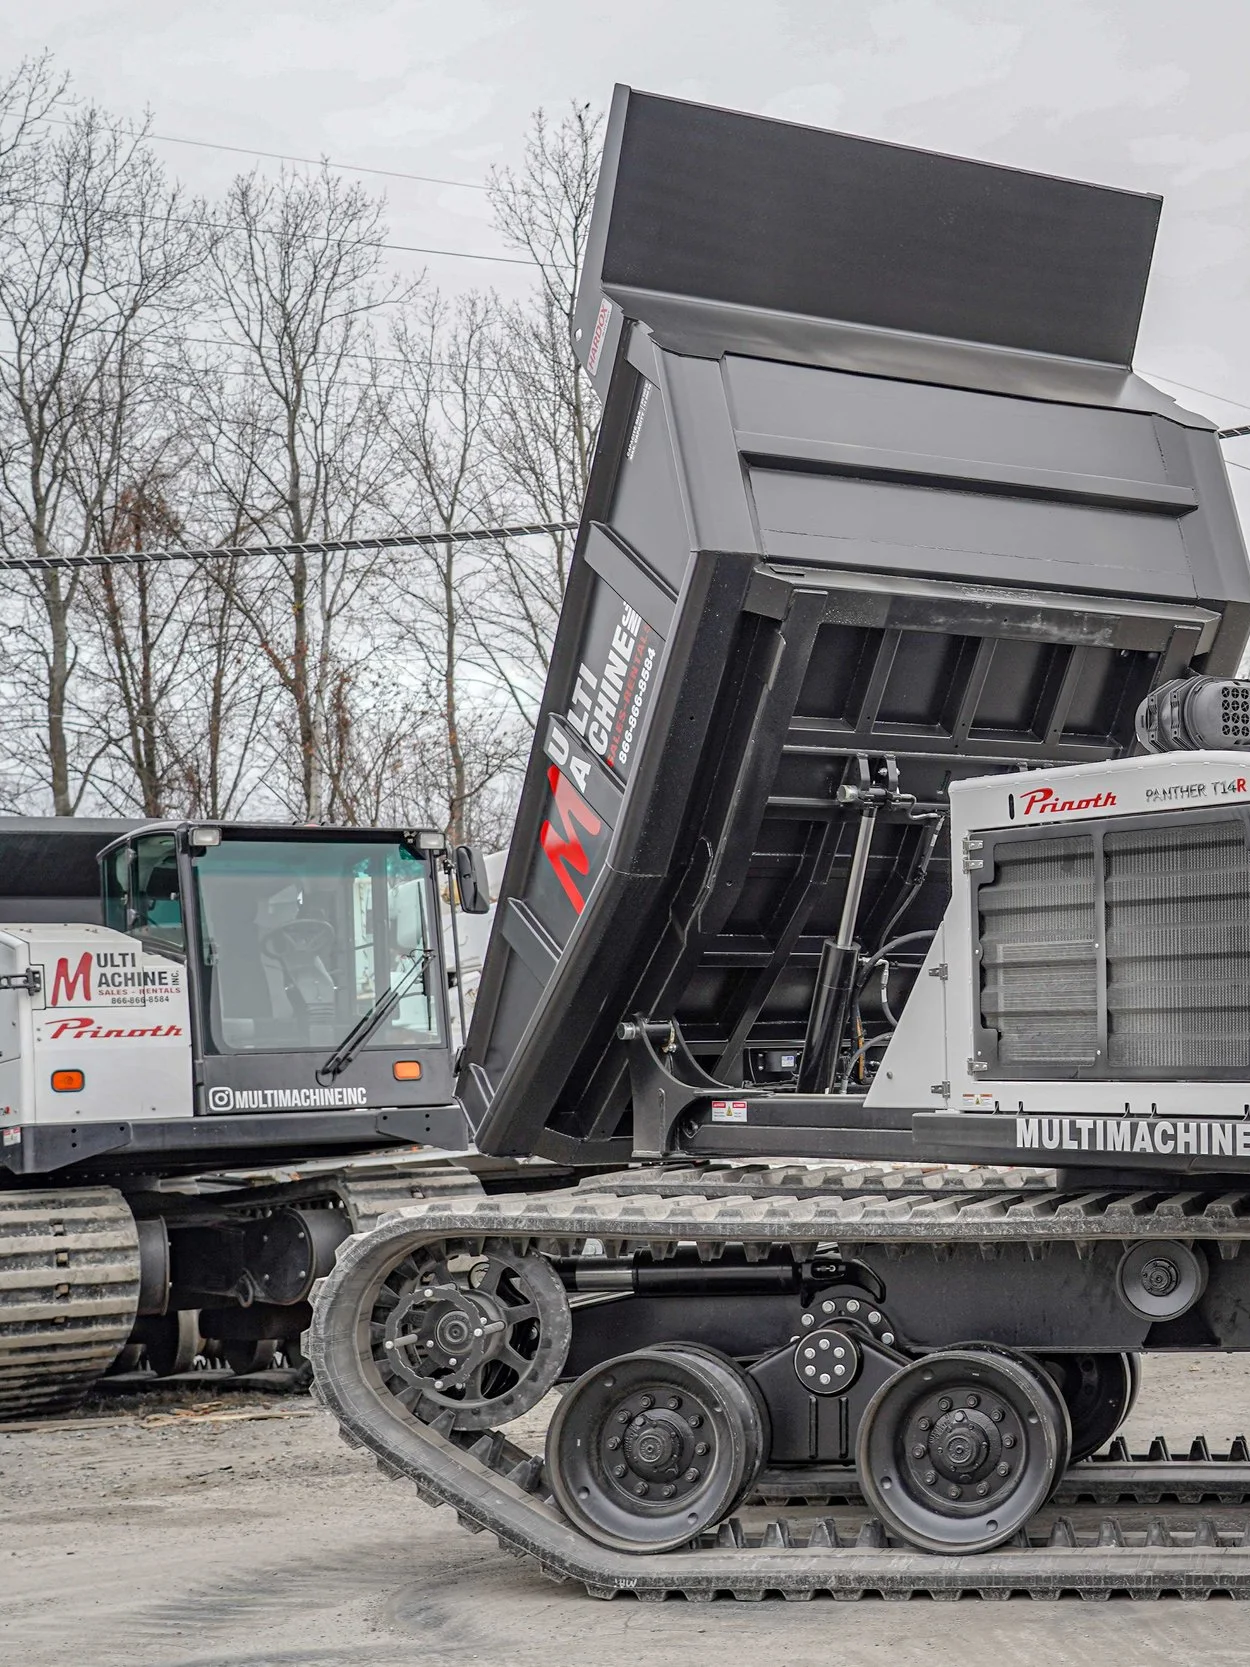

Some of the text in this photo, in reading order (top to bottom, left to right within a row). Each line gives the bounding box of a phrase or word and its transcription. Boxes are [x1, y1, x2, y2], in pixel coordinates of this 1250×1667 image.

[588, 307, 608, 370] HARDOX
[619, 647, 656, 765] 866-866-8584
[1020, 778, 1247, 815] Prinoth PANTHER T14R
[111, 996, 170, 1004] 866-866-8584
[139, 988, 181, 996] RENTALS
[45, 1017, 183, 1039] Prinoth
[235, 1087, 368, 1109] MULTIMACHINEINC
